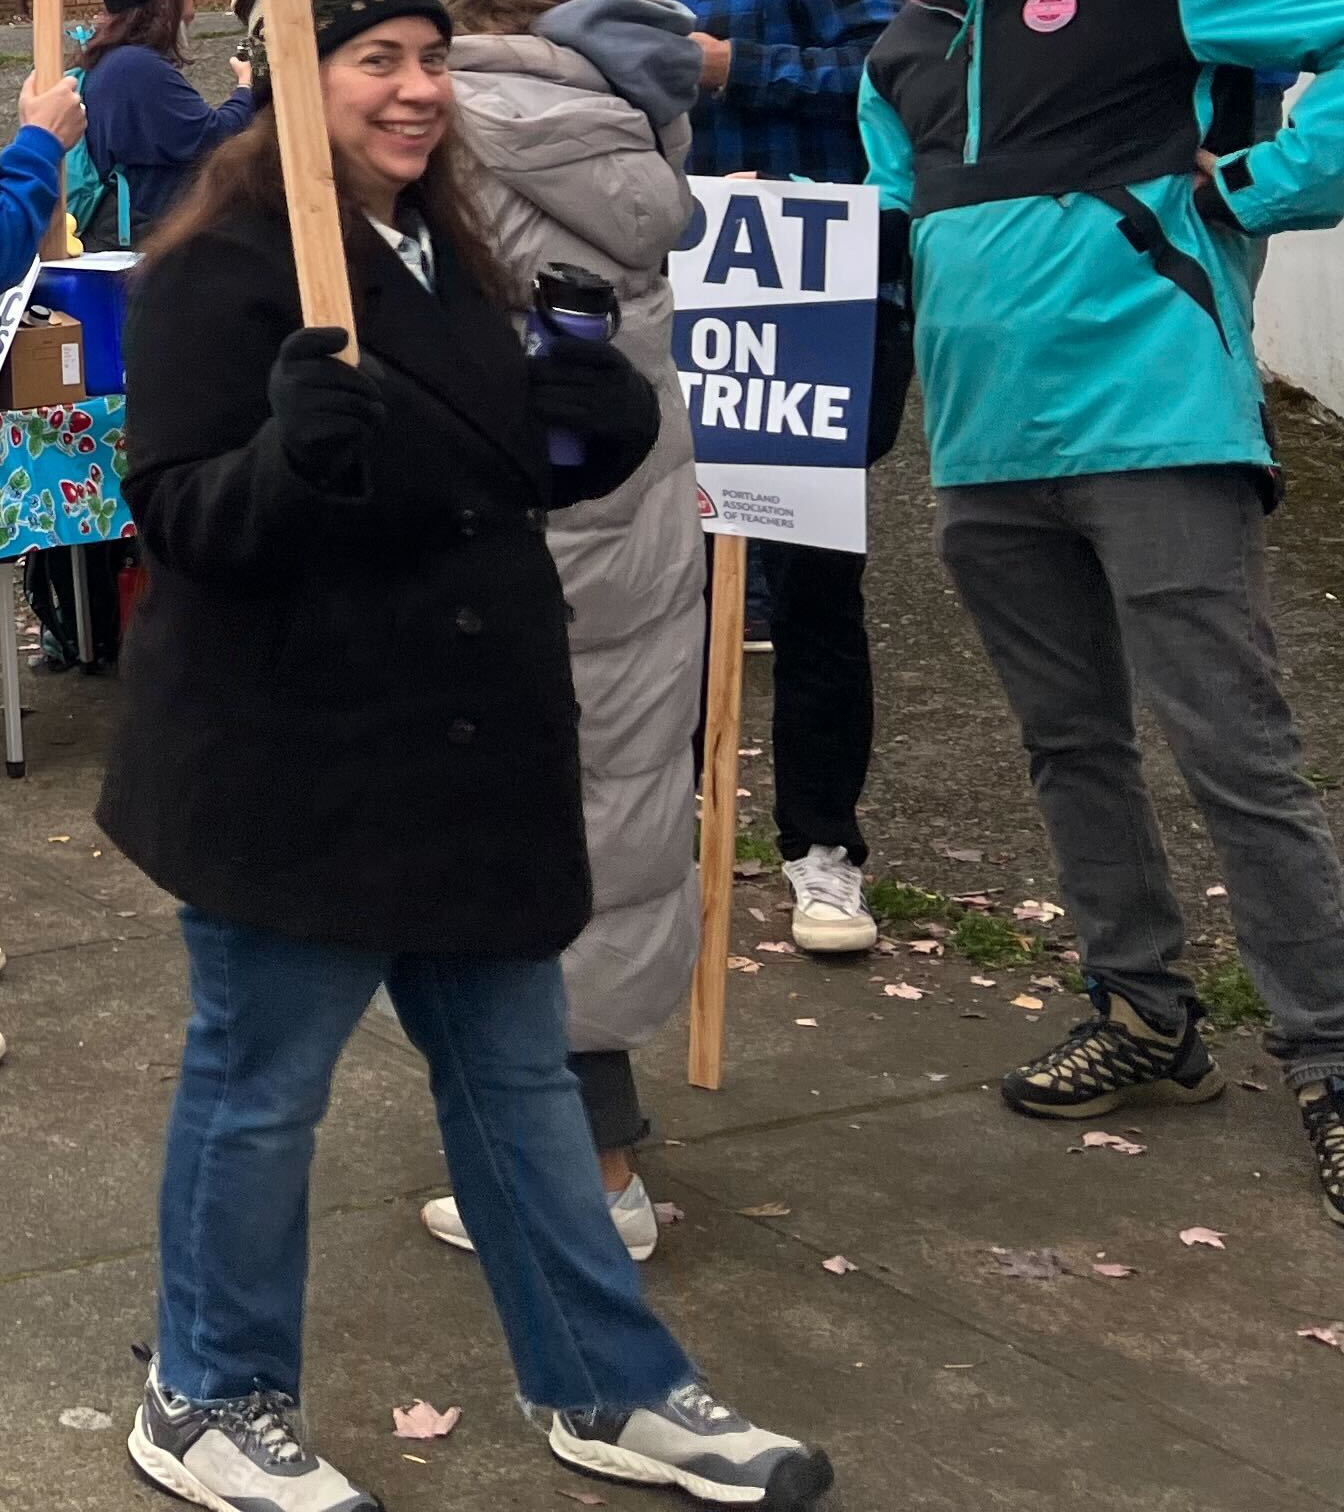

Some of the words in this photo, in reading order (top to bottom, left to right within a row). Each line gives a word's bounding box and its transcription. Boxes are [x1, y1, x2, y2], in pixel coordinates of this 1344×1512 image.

[691, 317, 777, 376] ON
[677, 371, 851, 441] TRIKE
[722, 489, 780, 504] PORTLAND
[723, 500, 794, 517] ASSOCIATION
[724, 511, 738, 520] OF
[740, 512, 794, 528] TEACHERS
